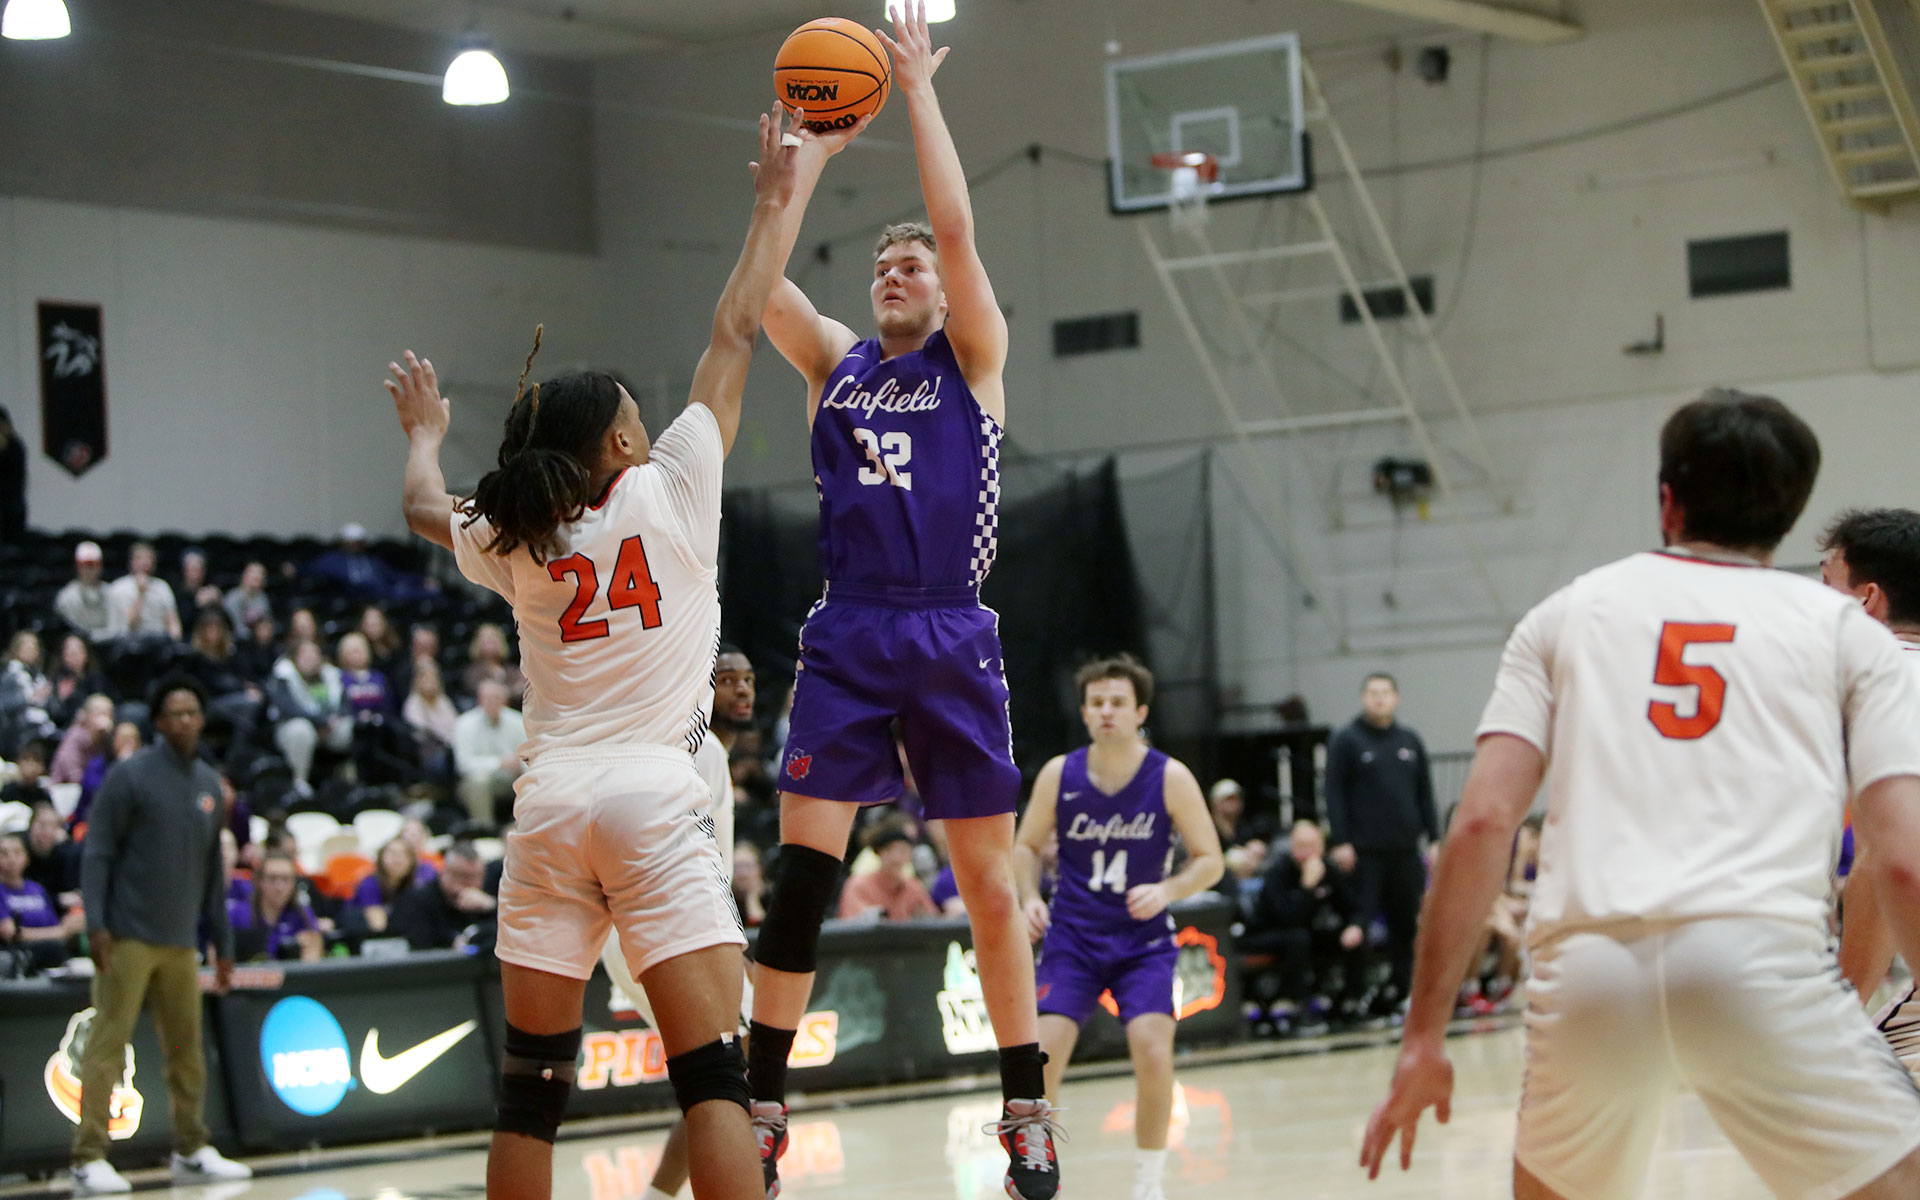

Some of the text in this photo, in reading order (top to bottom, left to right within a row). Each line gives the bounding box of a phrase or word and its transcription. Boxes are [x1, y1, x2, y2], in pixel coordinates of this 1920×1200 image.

[786, 83, 839, 101] NCAA
[823, 375, 942, 420] Linfield
[852, 427, 912, 491] 32
[547, 534, 663, 644] 24
[1647, 620, 1736, 739] 5
[1066, 812, 1156, 845] Linfield
[1088, 849, 1127, 894] 14
